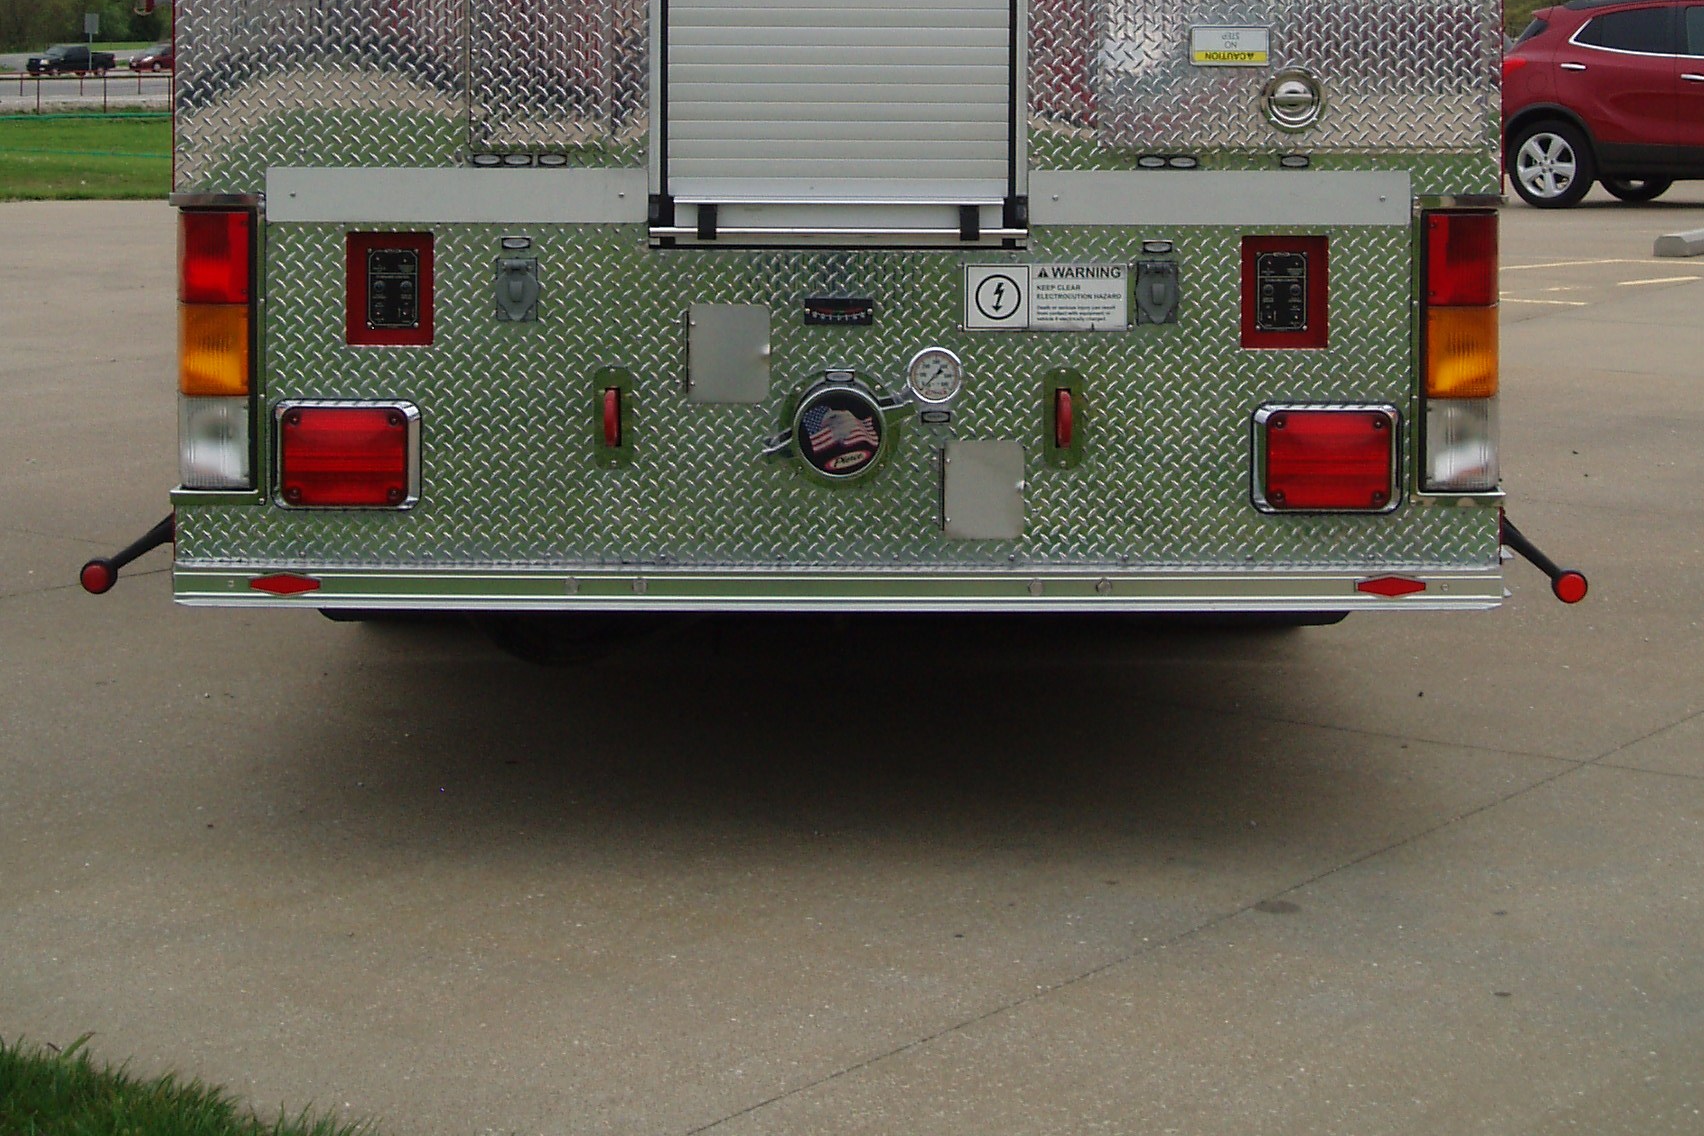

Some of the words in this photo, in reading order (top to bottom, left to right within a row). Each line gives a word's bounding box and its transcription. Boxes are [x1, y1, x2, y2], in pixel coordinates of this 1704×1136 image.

[1221, 32, 1240, 40] STEP
[1224, 40, 1237, 49] NO
[1204, 52, 1247, 60] CAUTION
[1051, 266, 1121, 279] WARNING
